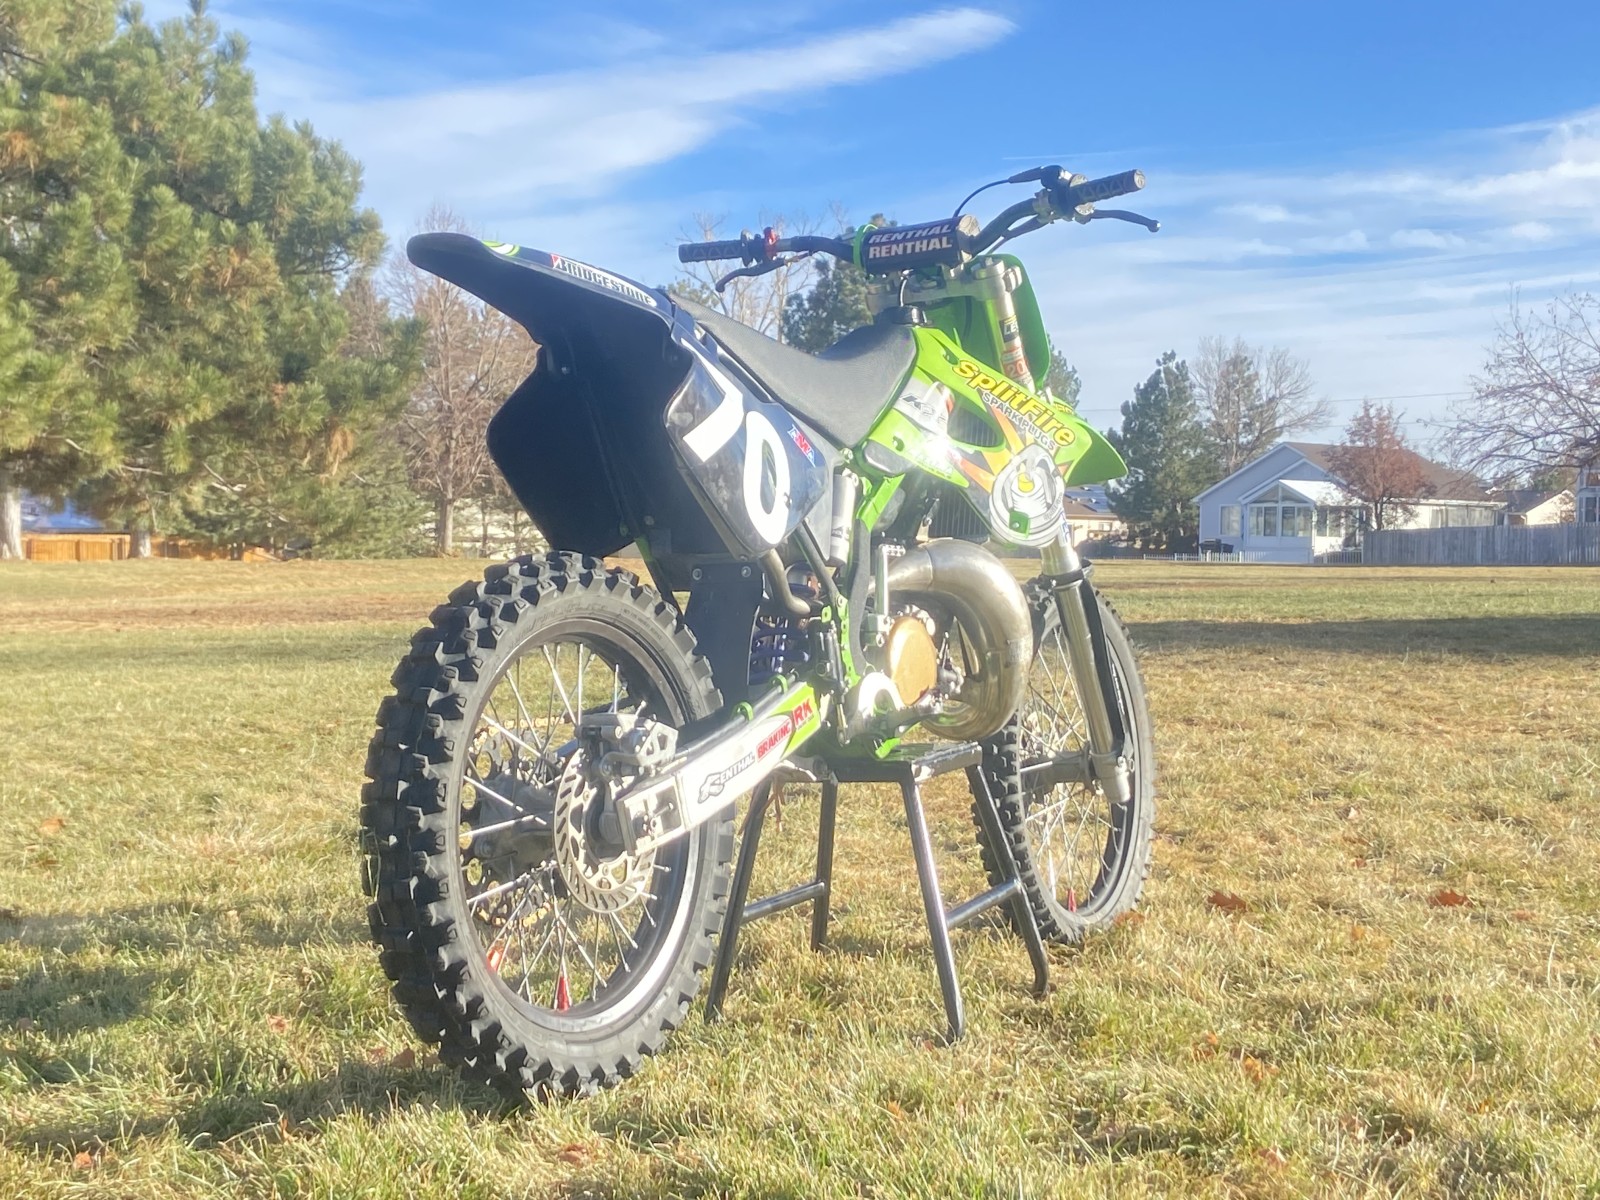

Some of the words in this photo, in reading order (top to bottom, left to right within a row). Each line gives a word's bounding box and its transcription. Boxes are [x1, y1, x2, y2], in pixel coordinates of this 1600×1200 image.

[868, 224, 952, 244] RENTHAL
[868, 236, 953, 259] RENTHAL
[551, 254, 653, 305] BRIDGESTONE
[953, 360, 1076, 447] SplitFire
[982, 392, 1021, 424] SPARK
[1021, 420, 1056, 451] PLUGS
[793, 699, 813, 724] RK
